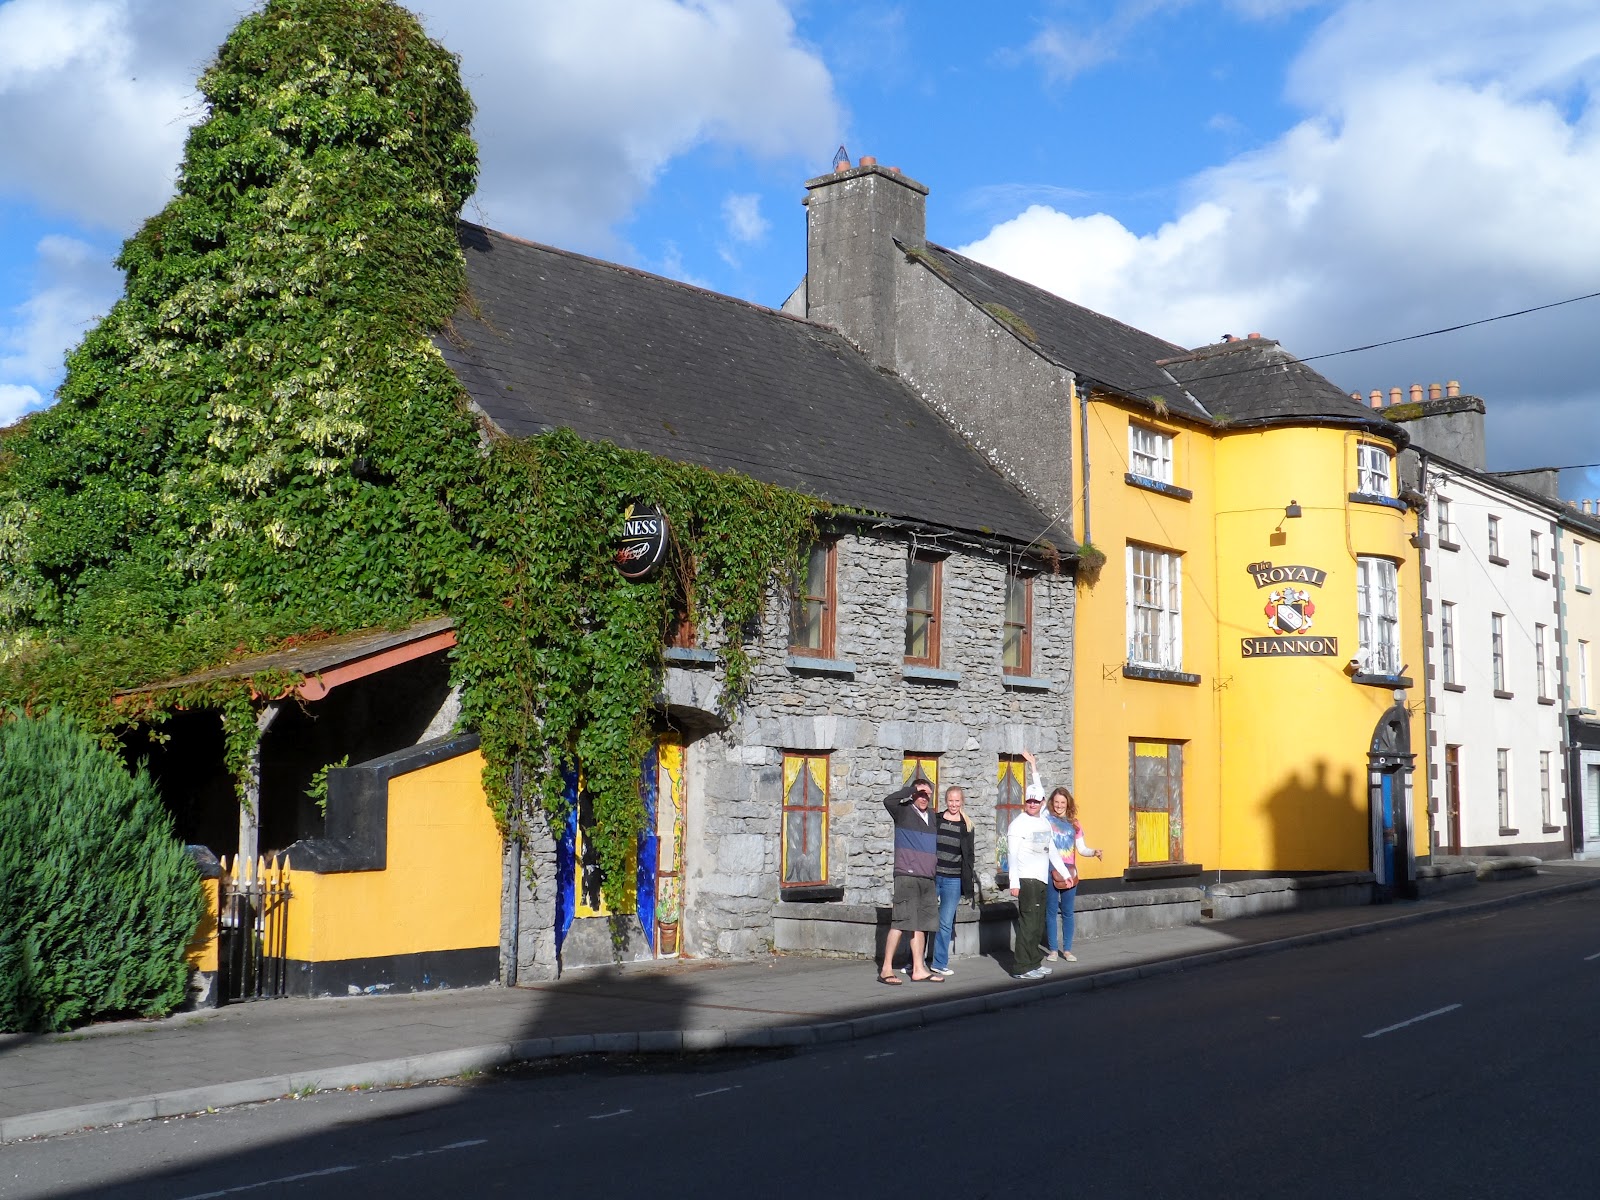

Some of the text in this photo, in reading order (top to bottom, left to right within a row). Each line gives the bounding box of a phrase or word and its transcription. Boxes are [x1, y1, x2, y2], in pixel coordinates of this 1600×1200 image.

[1247, 561, 1271, 573] The
[1256, 567, 1323, 586] ROYAL
[1242, 638, 1337, 656] SHANNON
